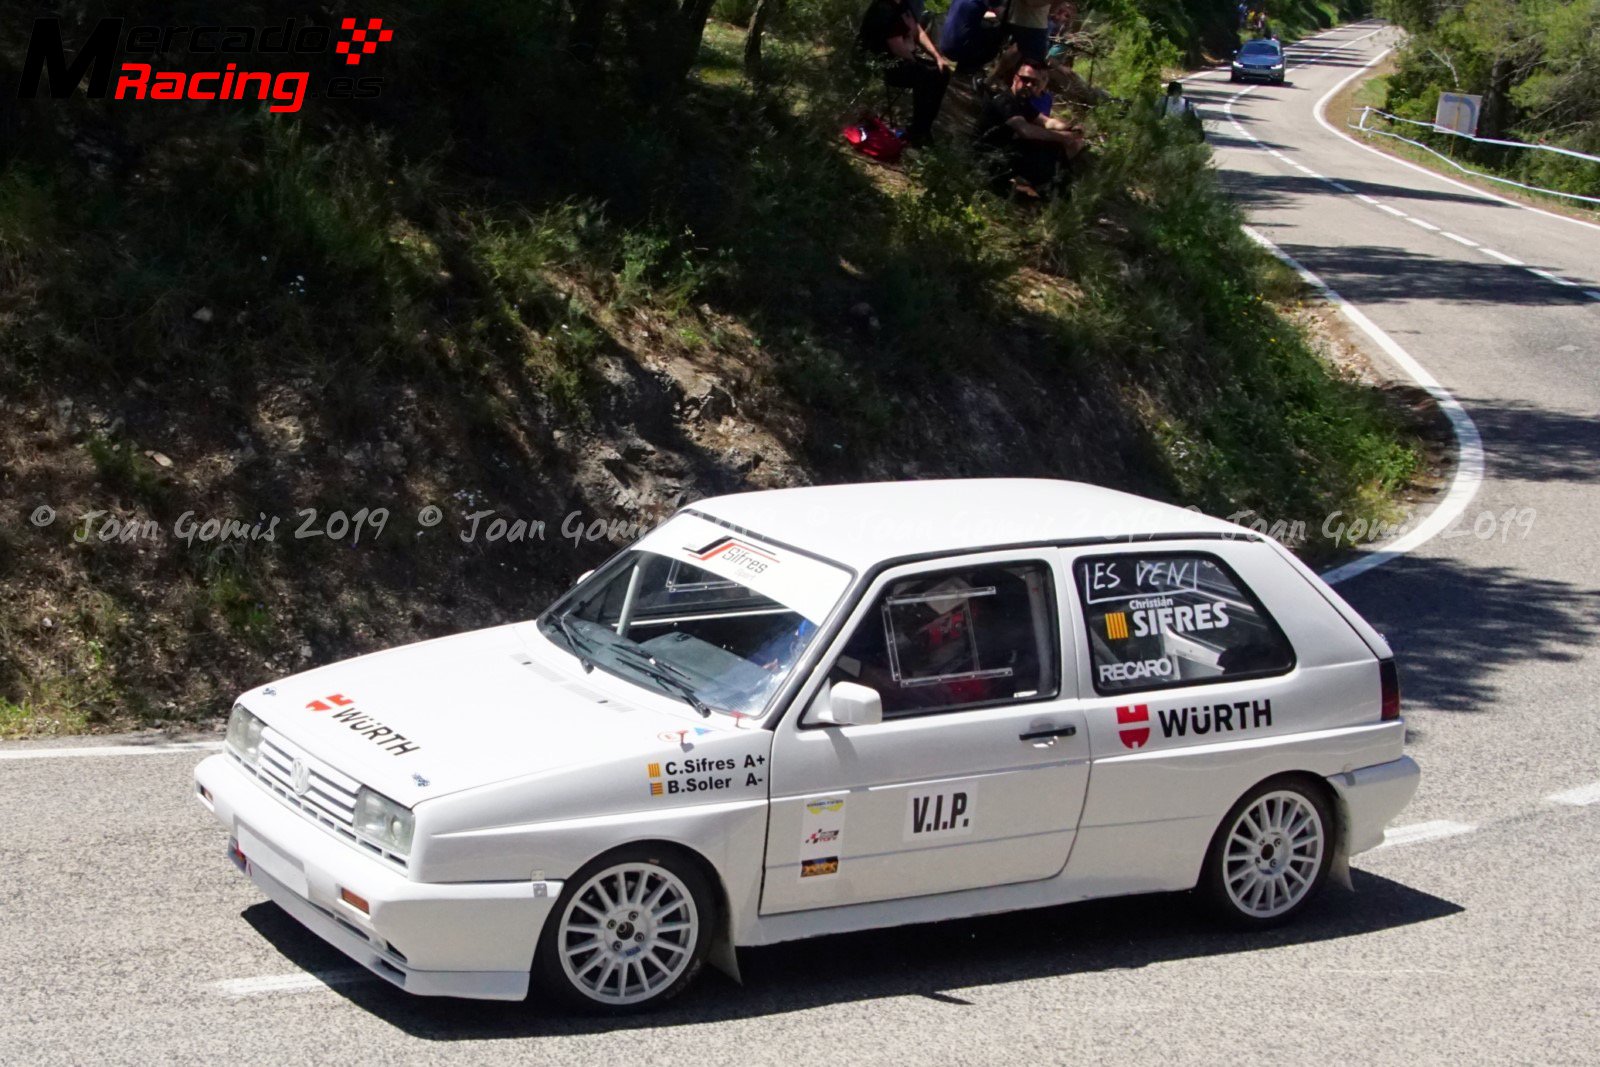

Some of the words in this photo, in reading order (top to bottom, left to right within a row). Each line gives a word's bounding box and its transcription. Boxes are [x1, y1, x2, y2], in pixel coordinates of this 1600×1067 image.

[722, 546, 769, 574] Sifres
[1132, 602, 1230, 638] SIFRES
[1100, 657, 1173, 682] RECARO
[331, 707, 421, 756] WÜRTH
[1157, 698, 1273, 739] WÜRTH
[665, 758, 736, 776] C.Sifres
[743, 754, 766, 769] A+
[667, 776, 732, 794] B.Soler
[745, 772, 763, 787] A-
[912, 792, 970, 834] V.I.P.
